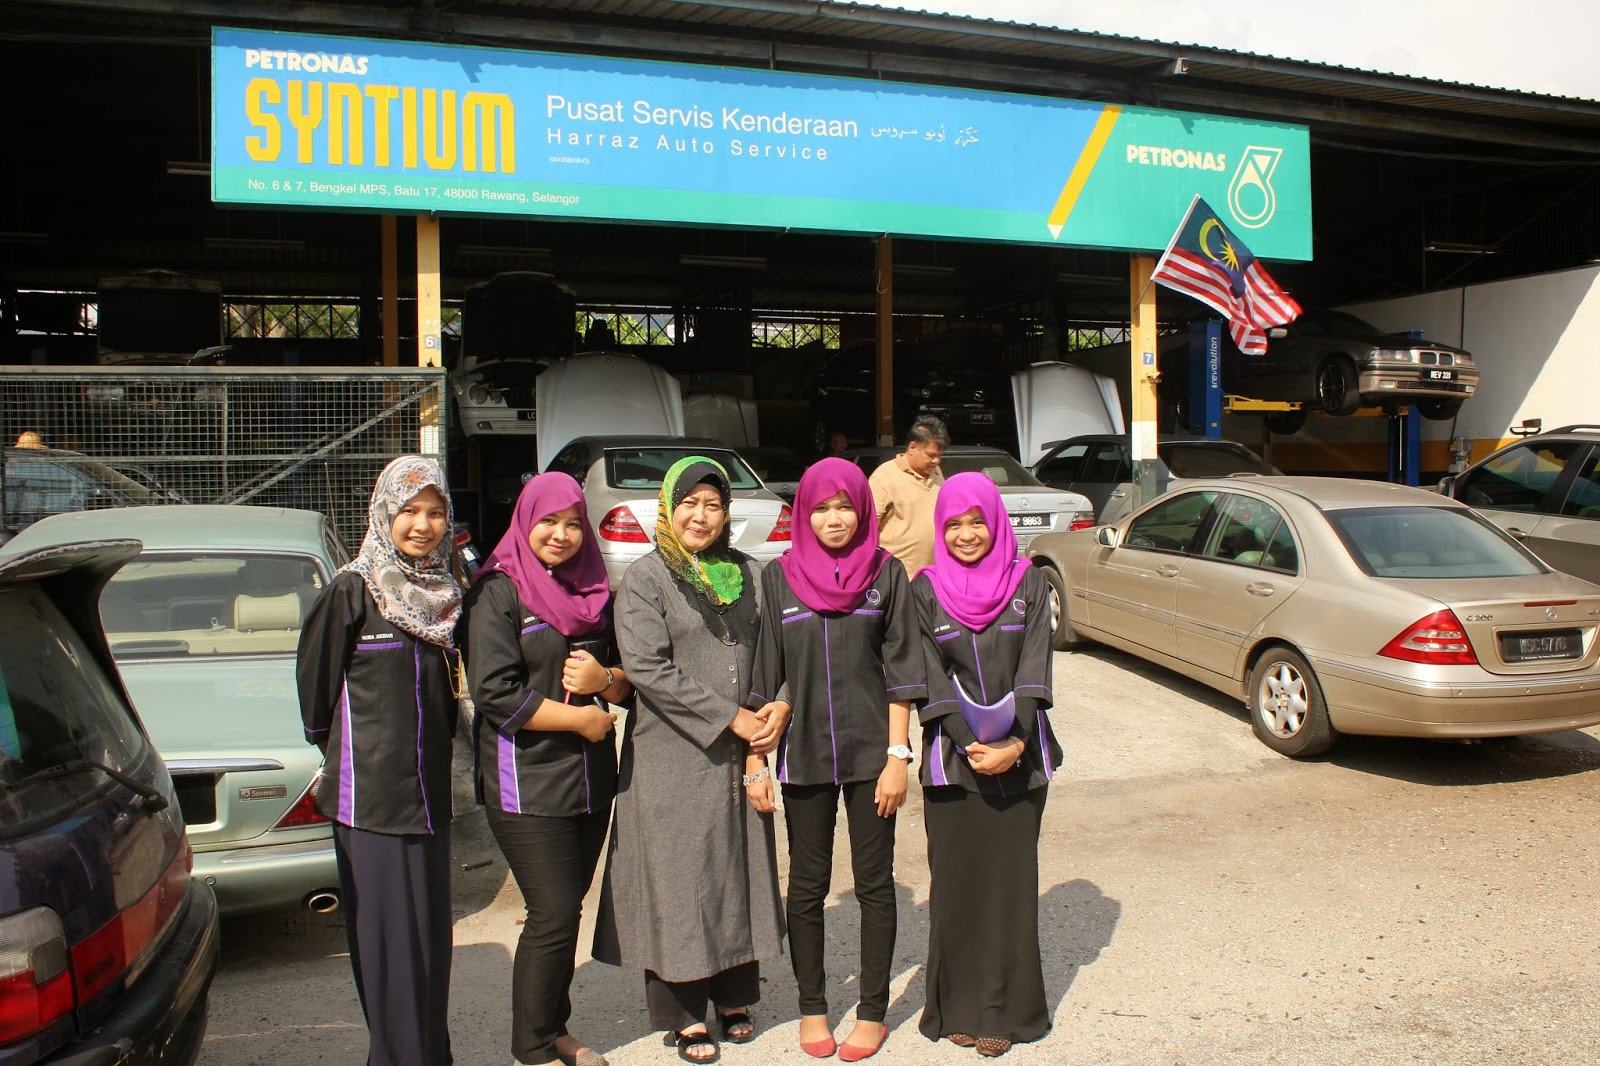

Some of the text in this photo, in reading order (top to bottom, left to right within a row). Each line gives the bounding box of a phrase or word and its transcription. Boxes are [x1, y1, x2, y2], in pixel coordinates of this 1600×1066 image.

[245, 49, 369, 75] PETRONAS
[245, 77, 516, 174] SYNTIUM
[546, 94, 858, 138] Pusat Servis Kenderaan
[546, 128, 828, 160] Harraz Auto Service
[1126, 144, 1226, 172] PETRONAS
[248, 179, 269, 190] No.
[272, 180, 280, 190] 6
[283, 180, 292, 191] &
[309, 182, 357, 196] Bengkel
[359, 184, 391, 197] MPS,
[394, 186, 420, 196] Batu
[423, 187, 441, 199] 17,
[443, 188, 478, 199] 48000
[481, 190, 529, 203] Rawang,
[532, 192, 580, 206] Selangor
[425, 336, 434, 348] 6
[1145, 353, 1153, 364] 7
[1022, 516, 1042, 526] 9863
[1474, 614, 1493, 622] 200
